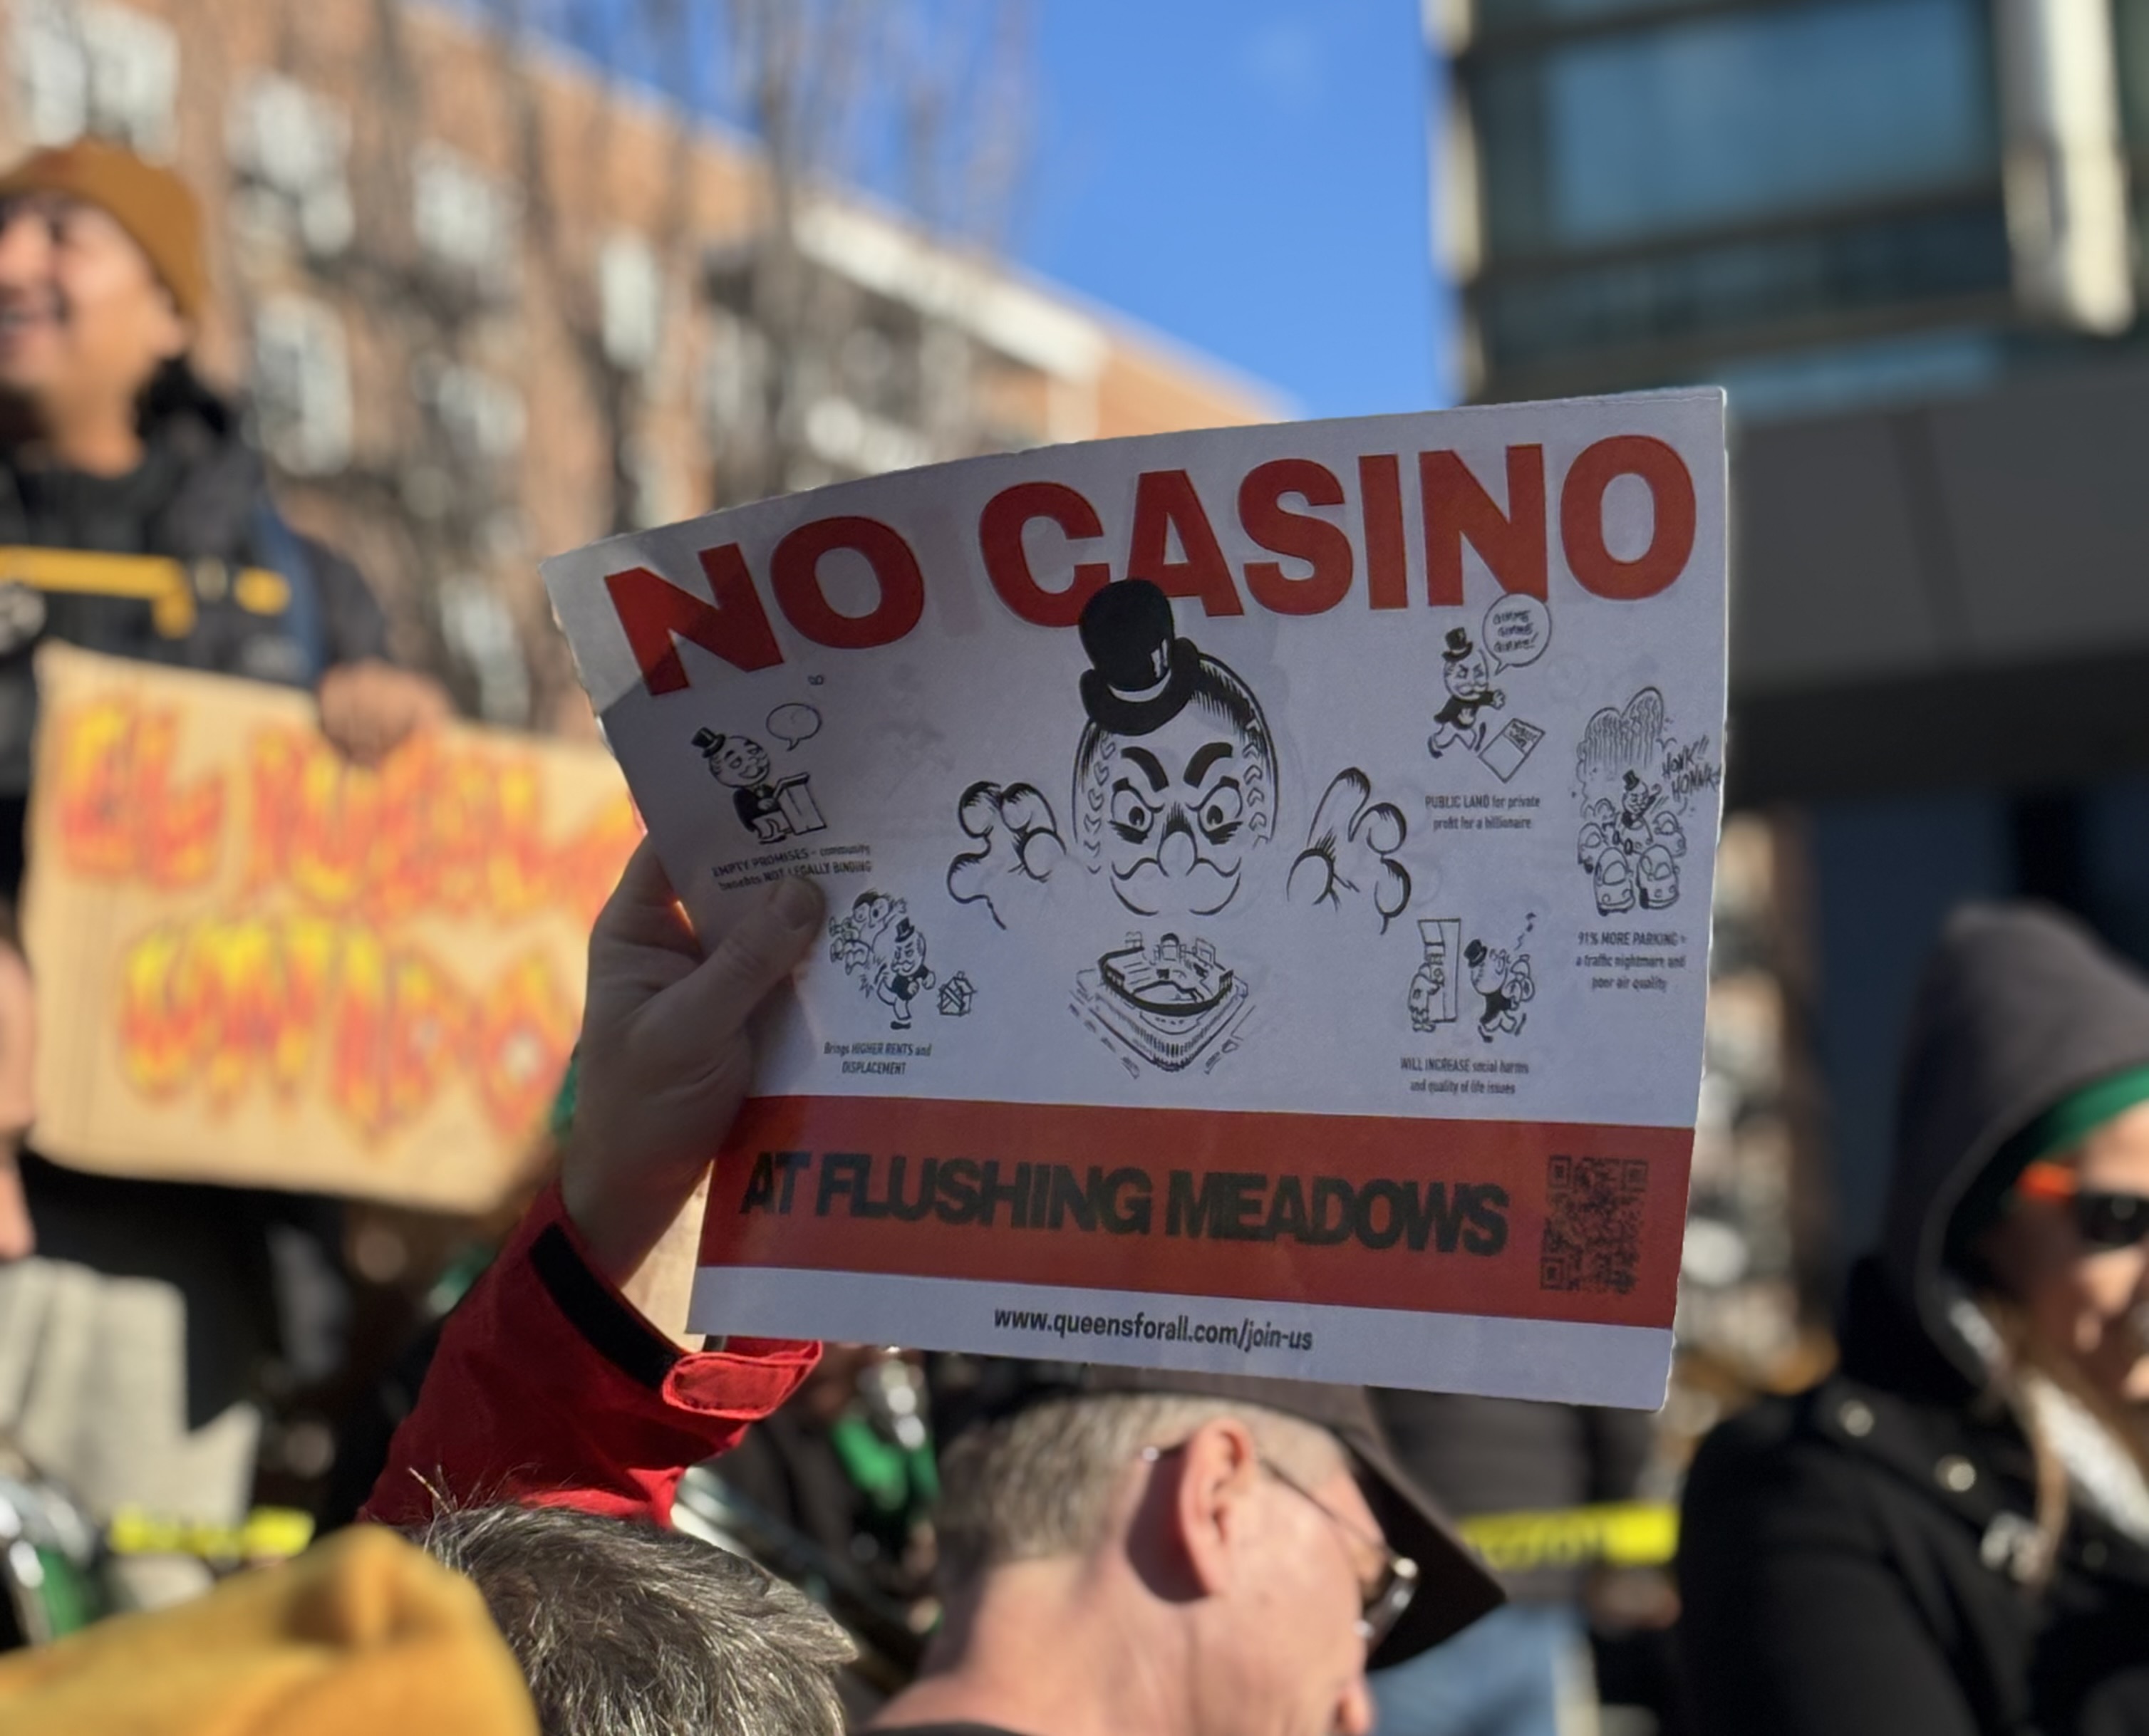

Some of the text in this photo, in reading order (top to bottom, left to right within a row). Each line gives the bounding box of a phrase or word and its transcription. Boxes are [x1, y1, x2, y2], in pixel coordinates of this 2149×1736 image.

[604, 435, 1697, 696] NO CASINO
[1425, 794, 1540, 810] PUBLIC LAND for private
[1434, 815, 1532, 832] profit for a billionaire
[712, 861, 749, 878] EMPTY
[752, 848, 809, 867] PROMISES
[819, 843, 871, 857] community
[718, 875, 762, 891] benefits
[763, 867, 784, 882] NOT
[833, 859, 873, 874] BINDING
[1578, 931, 1599, 946] 91%
[1601, 931, 1630, 946] MORE
[1632, 931, 1679, 947] PARKING
[1575, 952, 1687, 970] a traffic nightmare and
[1592, 974, 1667, 993] poor air quality
[824, 1041, 933, 1057] Brings HIGHER RENTS and
[842, 1060, 907, 1076] DISPLACEMENT
[1400, 1056, 1529, 1074] WILL INCREASE social harms
[1410, 1078, 1516, 1095] and quality of life issues
[740, 1151, 1510, 1257] AT FLUSHING MEADOWS
[994, 1309, 1313, 1353] www.queensforall.com/join-us
